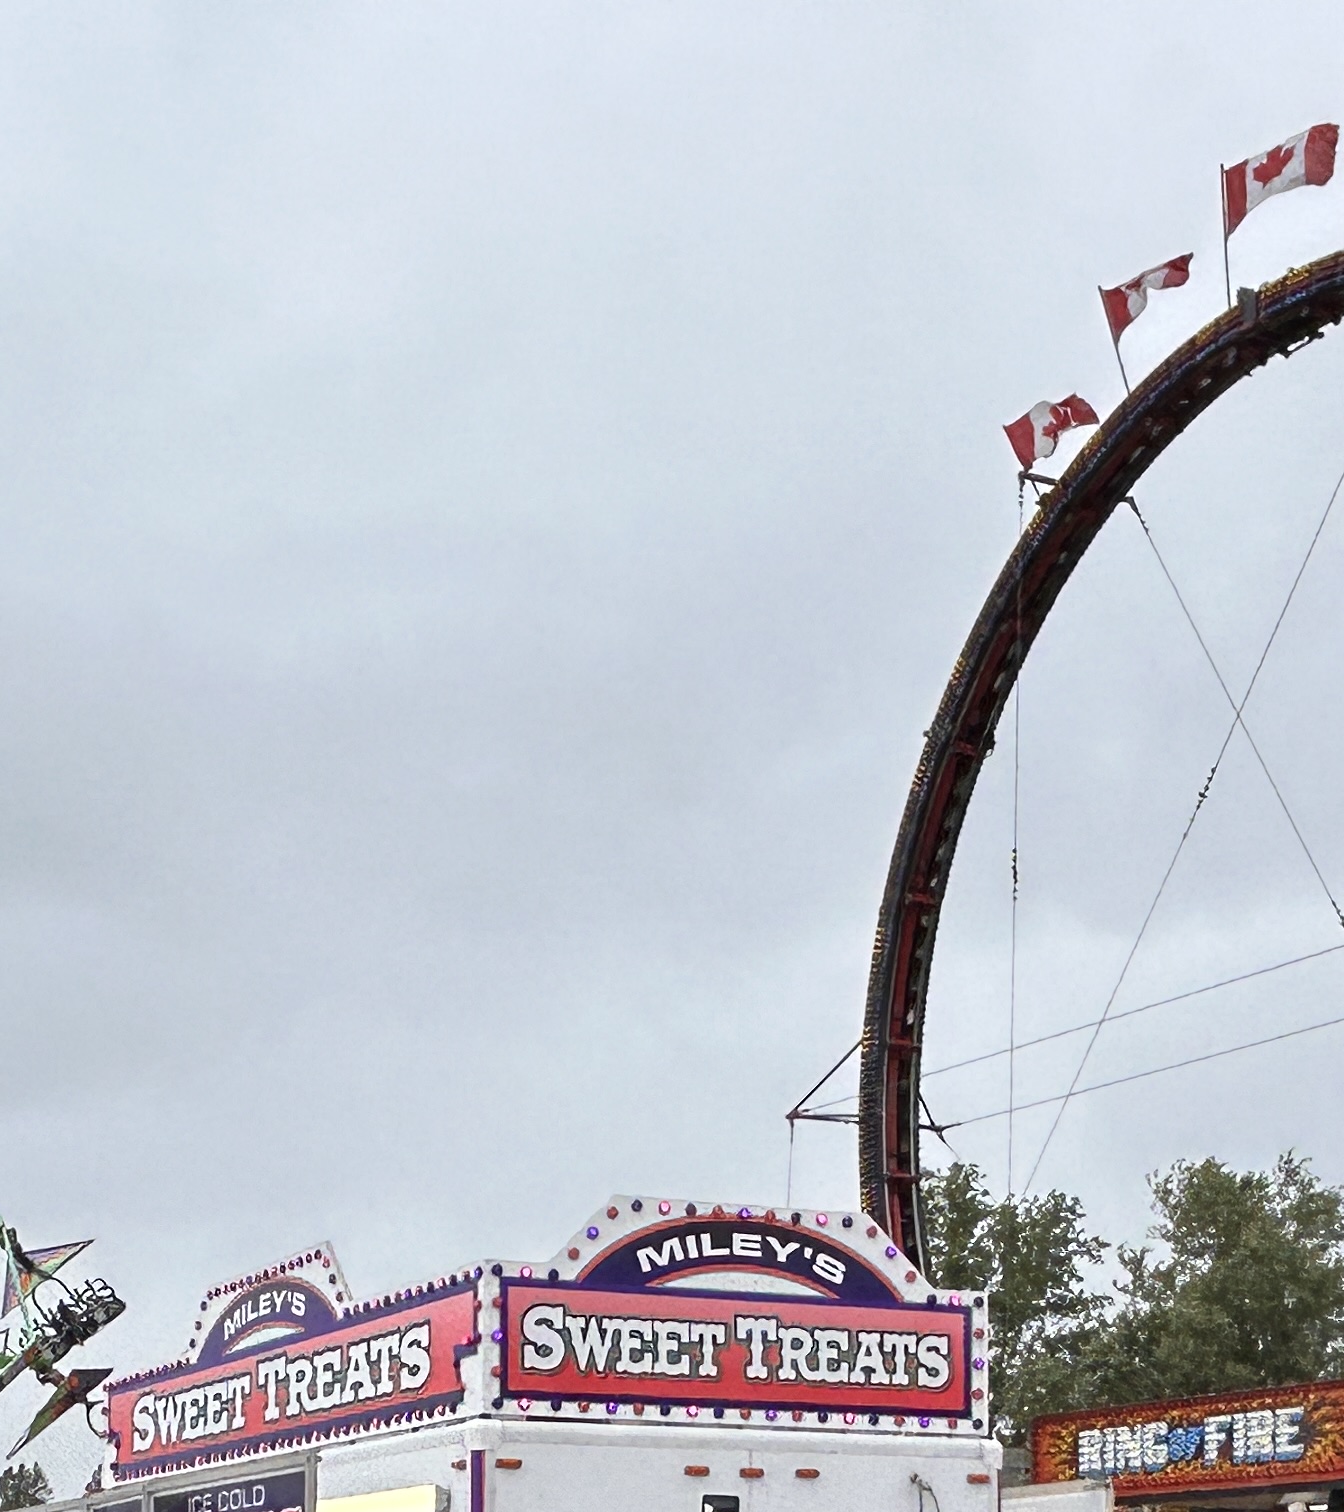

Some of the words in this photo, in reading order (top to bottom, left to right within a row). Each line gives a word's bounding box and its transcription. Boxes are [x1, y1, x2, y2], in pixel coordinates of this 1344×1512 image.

[636, 1232, 846, 1285] MILEY'S
[223, 1289, 306, 1340] MILEY'S
[522, 1304, 727, 1379] SWEET
[734, 1315, 950, 1389] TREATS
[131, 1371, 252, 1453] SWEET
[256, 1323, 432, 1421] TREATS
[217, 1484, 266, 1512] COLD
